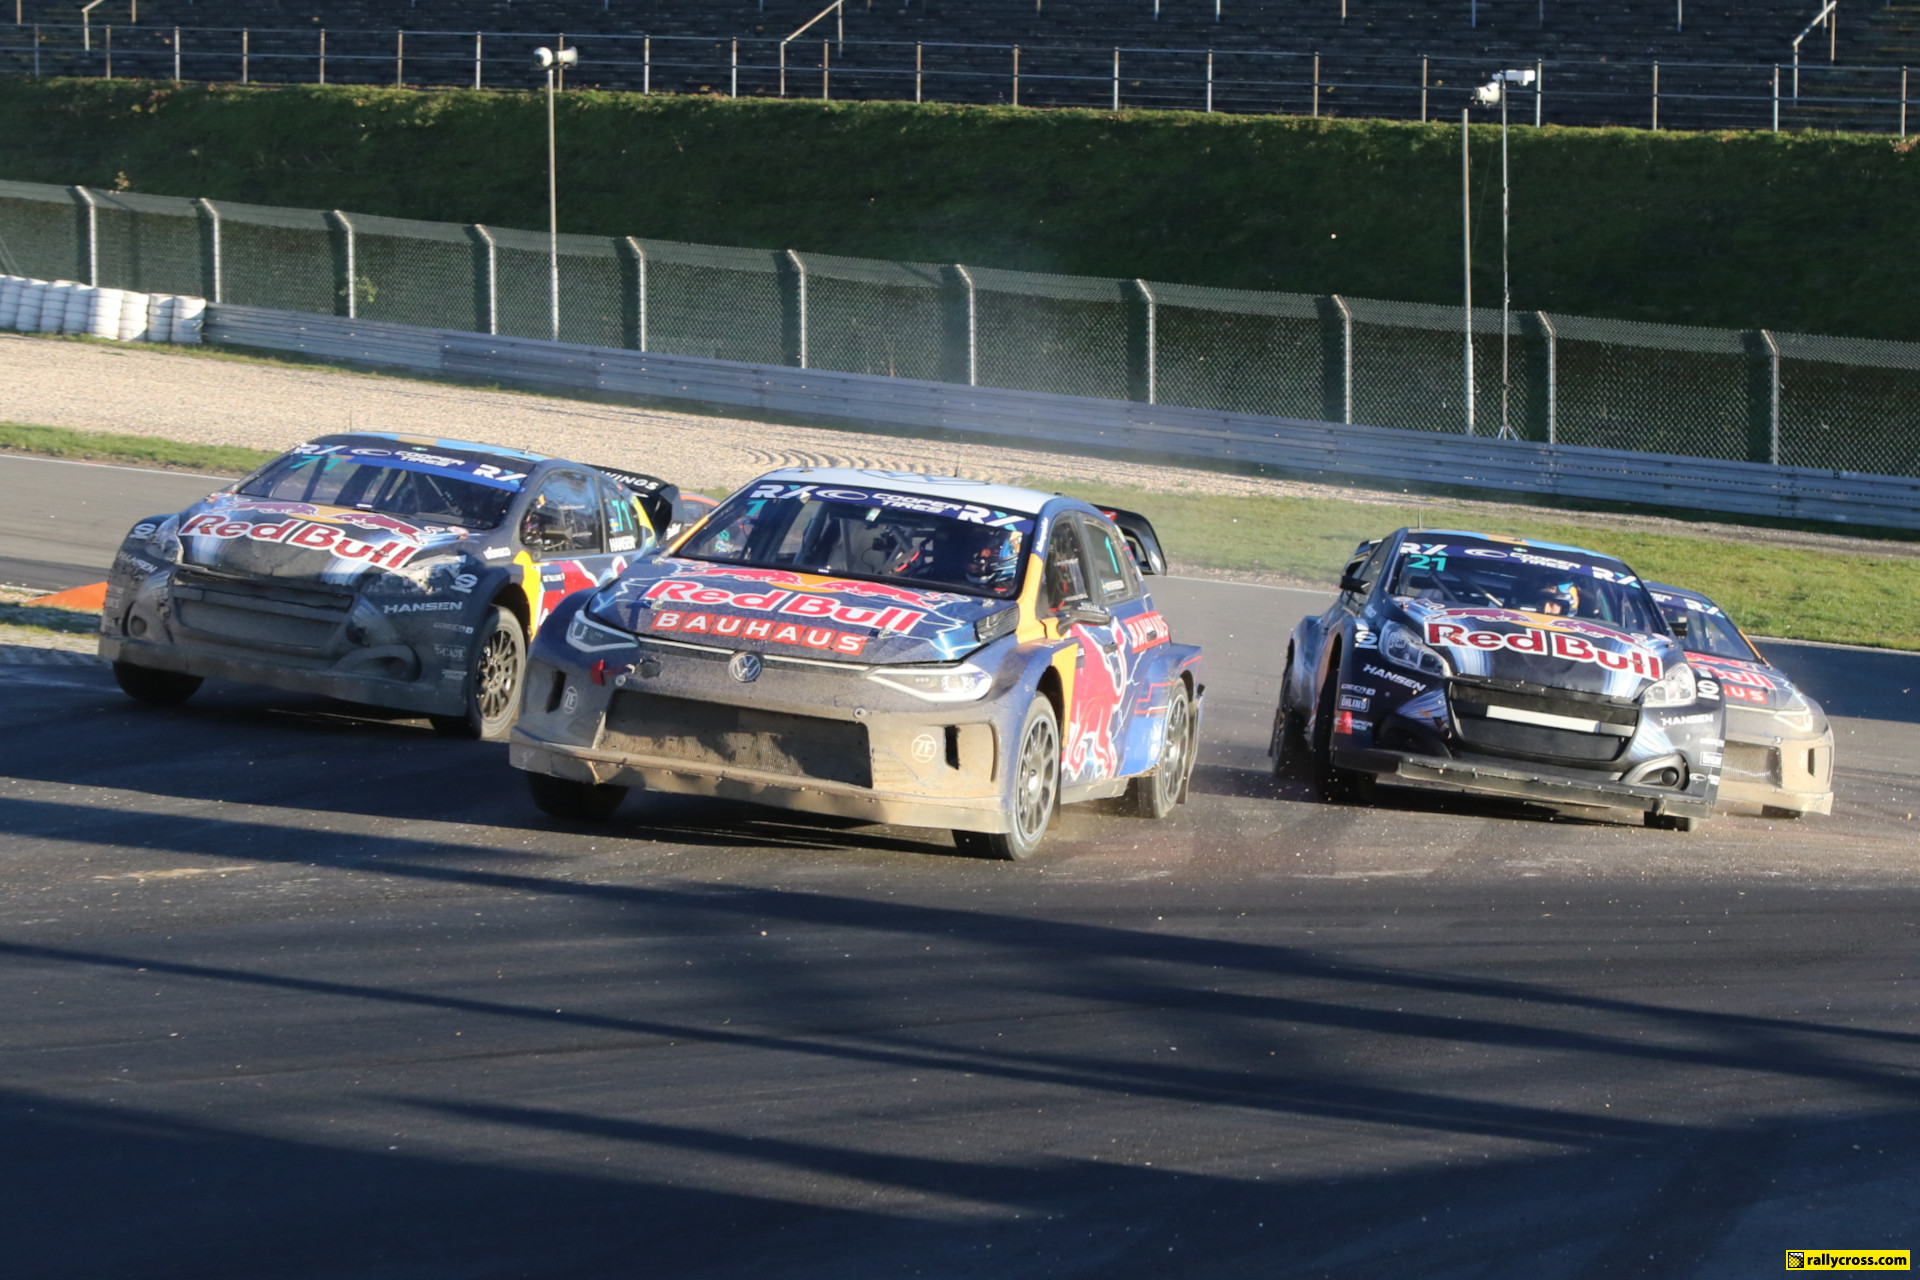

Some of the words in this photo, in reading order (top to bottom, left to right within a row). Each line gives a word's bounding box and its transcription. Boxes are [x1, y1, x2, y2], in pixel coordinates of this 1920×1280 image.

[290, 455, 343, 471] 71
[395, 450, 465, 466] COOPER
[401, 456, 451, 467] TIRES
[872, 493, 963, 512] COOPER
[882, 500, 943, 514] TIRES
[610, 499, 635, 532] 71
[179, 514, 303, 541] Red
[287, 523, 420, 569] Bull
[1407, 555, 1447, 572] 21
[1510, 552, 1581, 569] COOPER
[1520, 558, 1571, 571] TIRES
[381, 602, 464, 614] HANSEN
[646, 581, 793, 611] Red
[780, 594, 926, 633] Bull
[655, 611, 863, 651] BAUHAUS
[1426, 622, 1547, 655] Red
[1554, 633, 1663, 681] Bull
[1362, 663, 1427, 692] HANSEN
[1661, 714, 1714, 726] HANSEN
